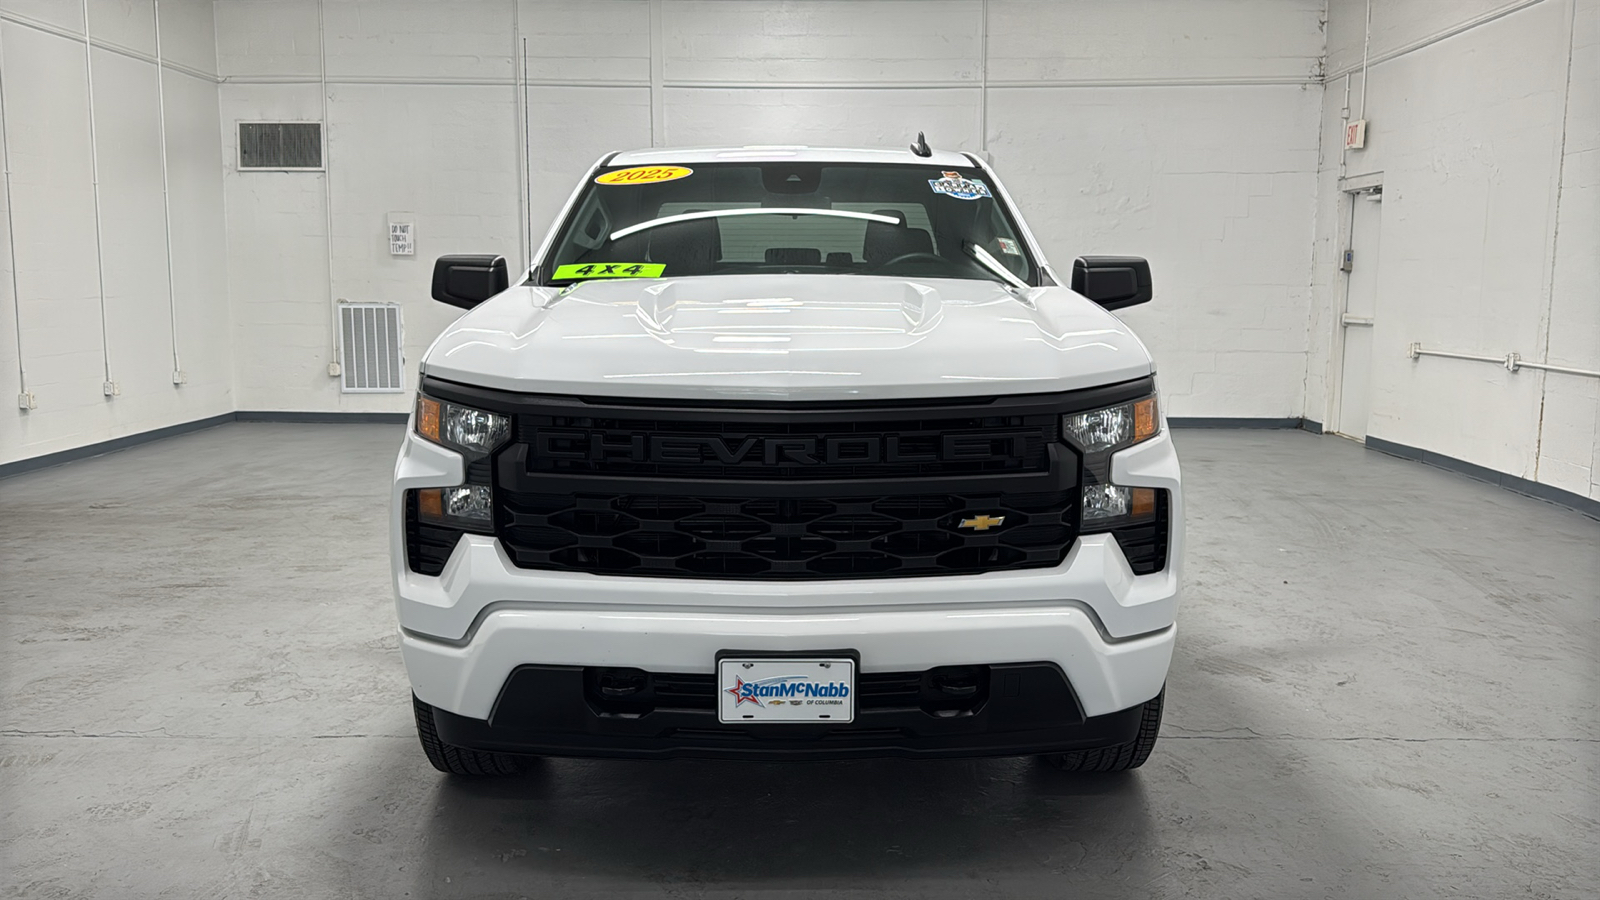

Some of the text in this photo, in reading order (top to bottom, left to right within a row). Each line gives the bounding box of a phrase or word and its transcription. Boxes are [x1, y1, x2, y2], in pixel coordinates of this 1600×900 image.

[1347, 124, 1358, 145] EXIT
[609, 168, 678, 182] 2025
[391, 224, 410, 235] DO NOT
[391, 234, 407, 243] TOUCH
[536, 430, 1042, 465] CHEVROLET
